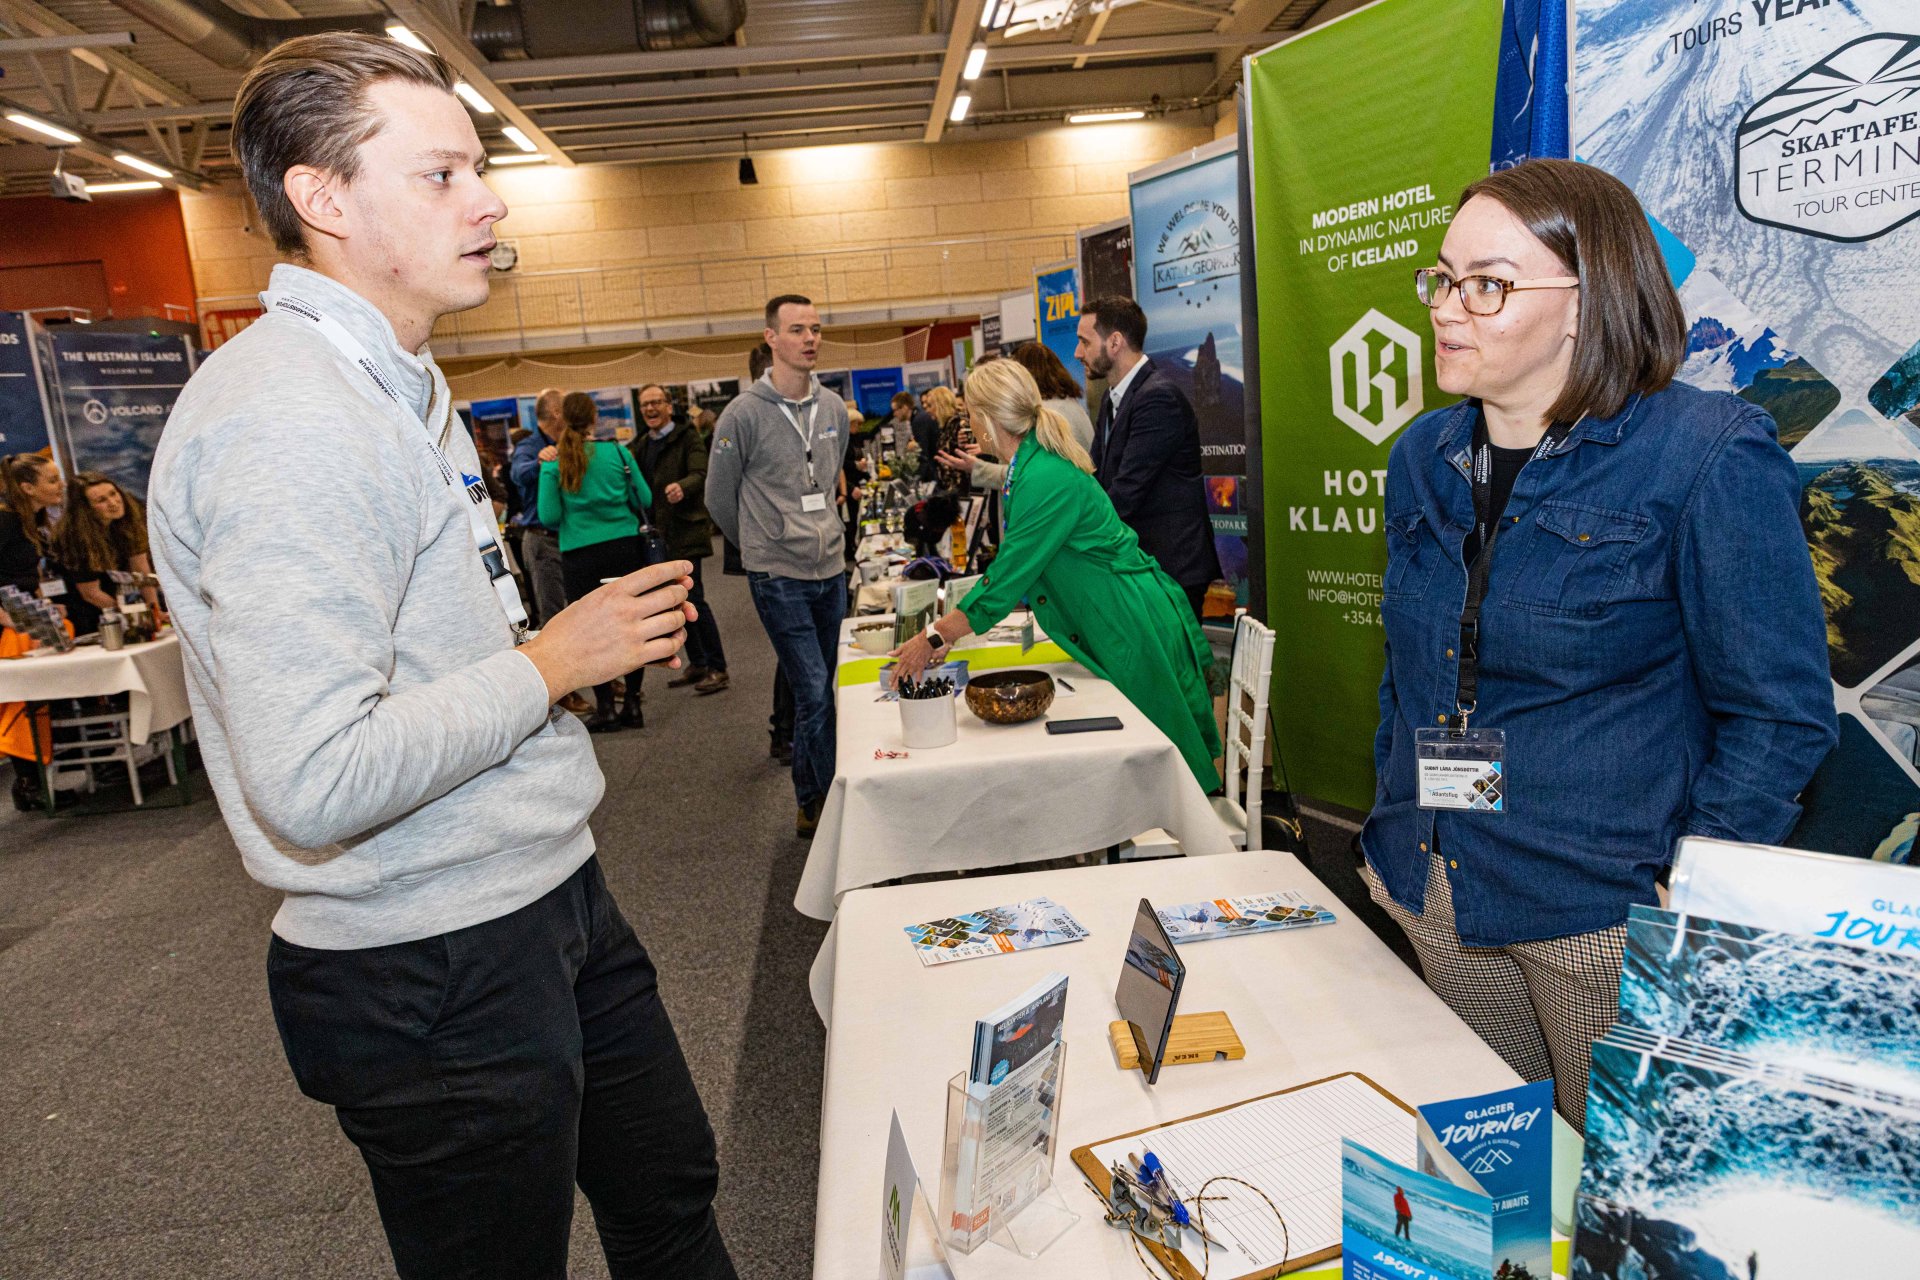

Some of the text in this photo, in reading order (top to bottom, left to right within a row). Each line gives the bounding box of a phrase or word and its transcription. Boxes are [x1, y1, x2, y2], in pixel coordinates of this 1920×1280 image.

[1669, 0, 1843, 54] TOURS YEA
[1781, 111, 1920, 158] SKAFTAFE
[1747, 136, 1920, 197] TERMIN
[1312, 184, 1435, 230] MODERN HOTEL
[1793, 181, 1920, 218] TOUR CENTE
[1157, 232, 1169, 254] WE
[1212, 201, 1230, 222] YOU
[1228, 218, 1240, 237] TO
[1299, 205, 1452, 256] IN DYNAMIC NATURE
[1327, 239, 1419, 273] OF ICELAND
[62, 351, 182, 362] THE WESTMAN ISLANDS
[110, 404, 163, 417] VOLCANO
[1323, 469, 1388, 497] HOT
[1289, 506, 1386, 535] KLAU
[1307, 587, 1384, 608] INFO@HOTE
[1342, 610, 1372, 625] +354
[1813, 910, 1920, 950] JOUR
[1439, 1107, 1542, 1147] JOURNEY
[1465, 1102, 1515, 1121] GLACIER
[1501, 1194, 1530, 1211] AWAITS
[1372, 1251, 1426, 1279] ABOUT
